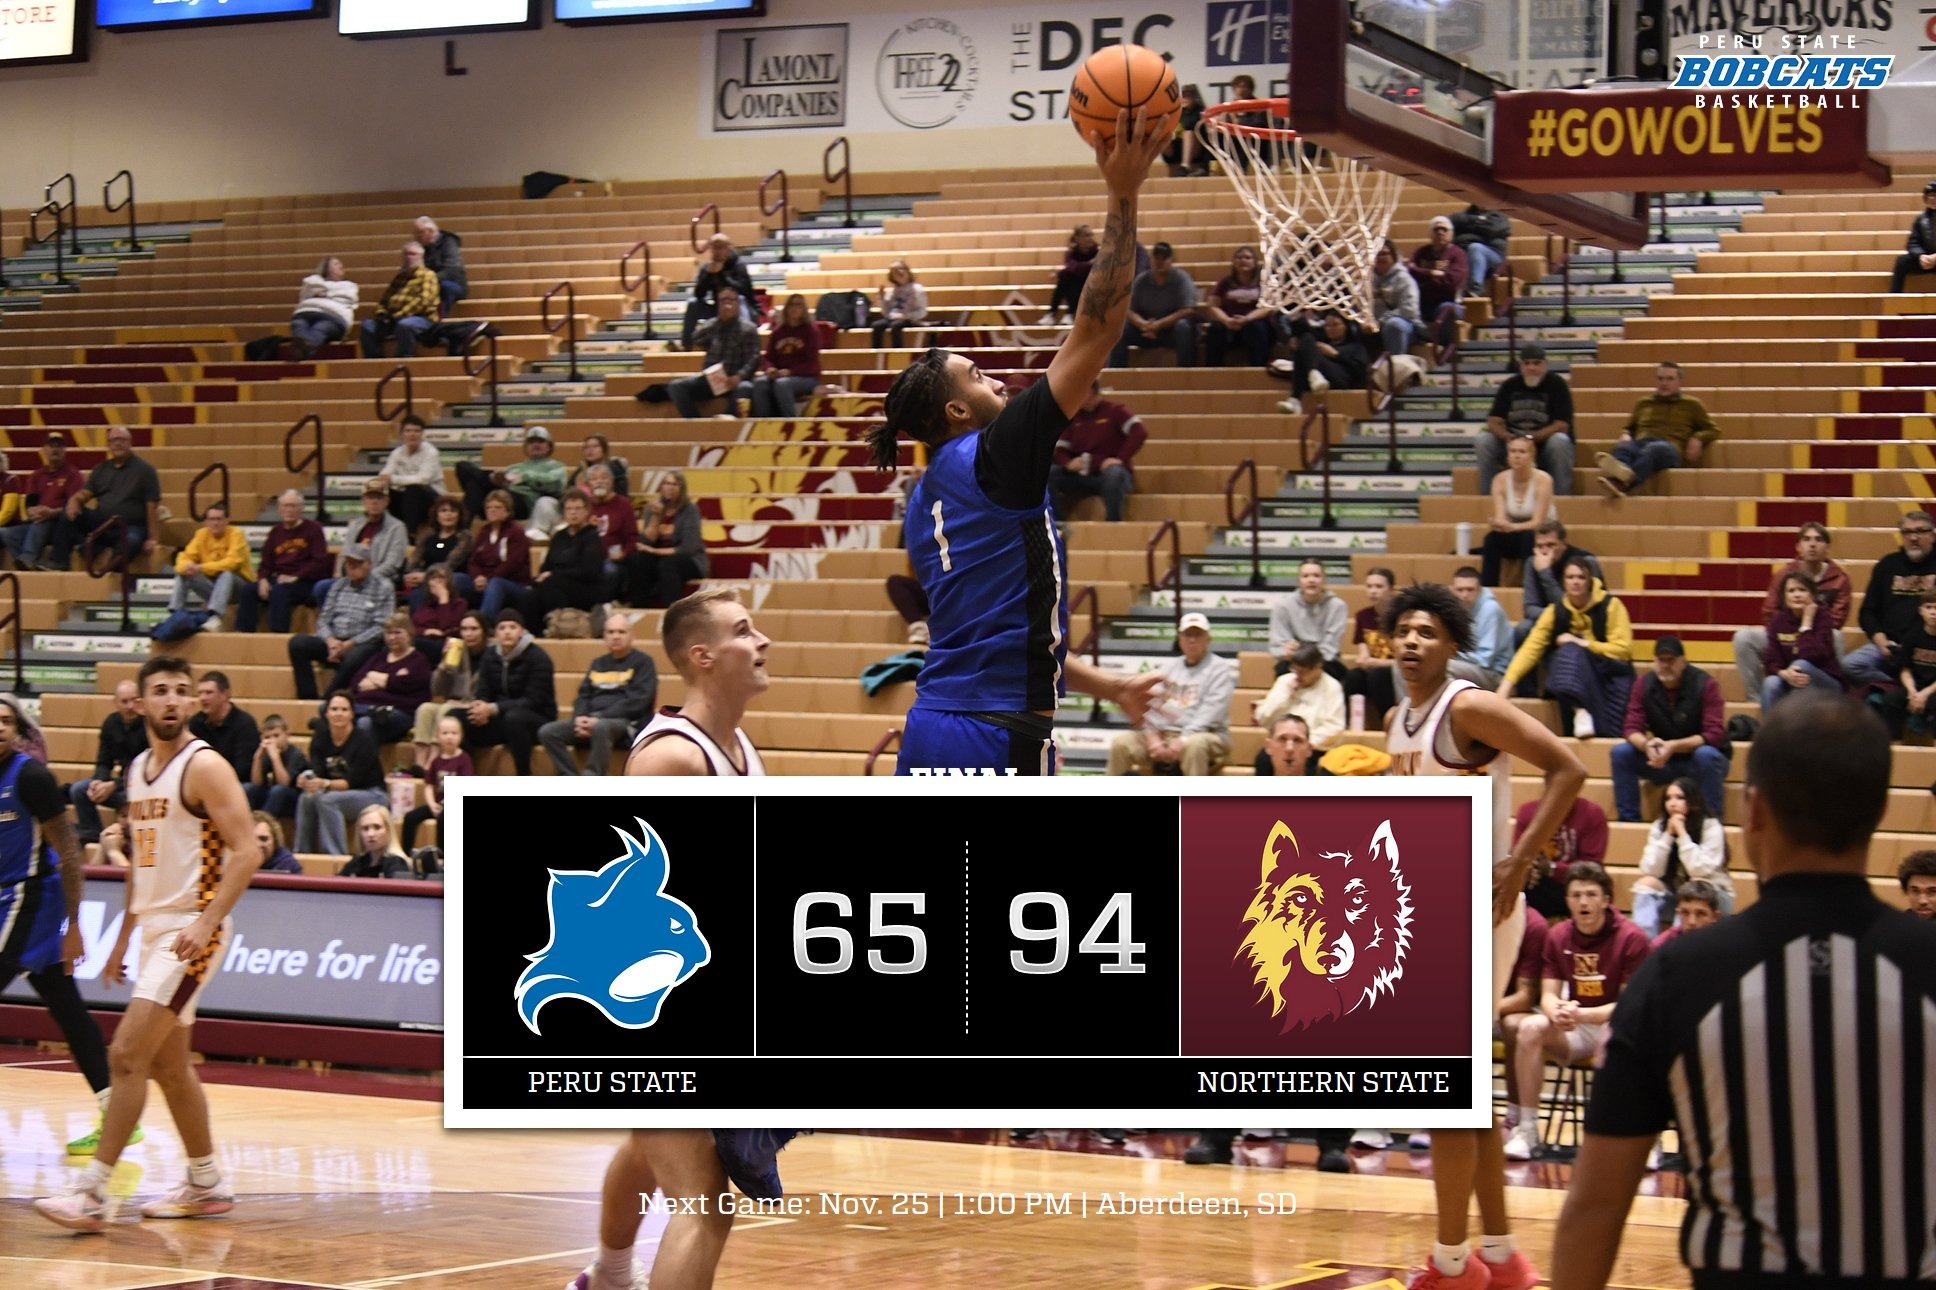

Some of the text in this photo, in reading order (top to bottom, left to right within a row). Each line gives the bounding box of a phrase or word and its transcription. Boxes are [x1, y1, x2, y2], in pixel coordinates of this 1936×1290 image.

[445, 41, 467, 76] L
[742, 38, 839, 87] LAMONT
[1011, 22, 1032, 74] THE
[719, 79, 838, 120] COMPANIES
[1527, 103, 1823, 157] #GOWOLVES
[931, 499, 952, 572] 1
[222, 933, 441, 985] here for life
